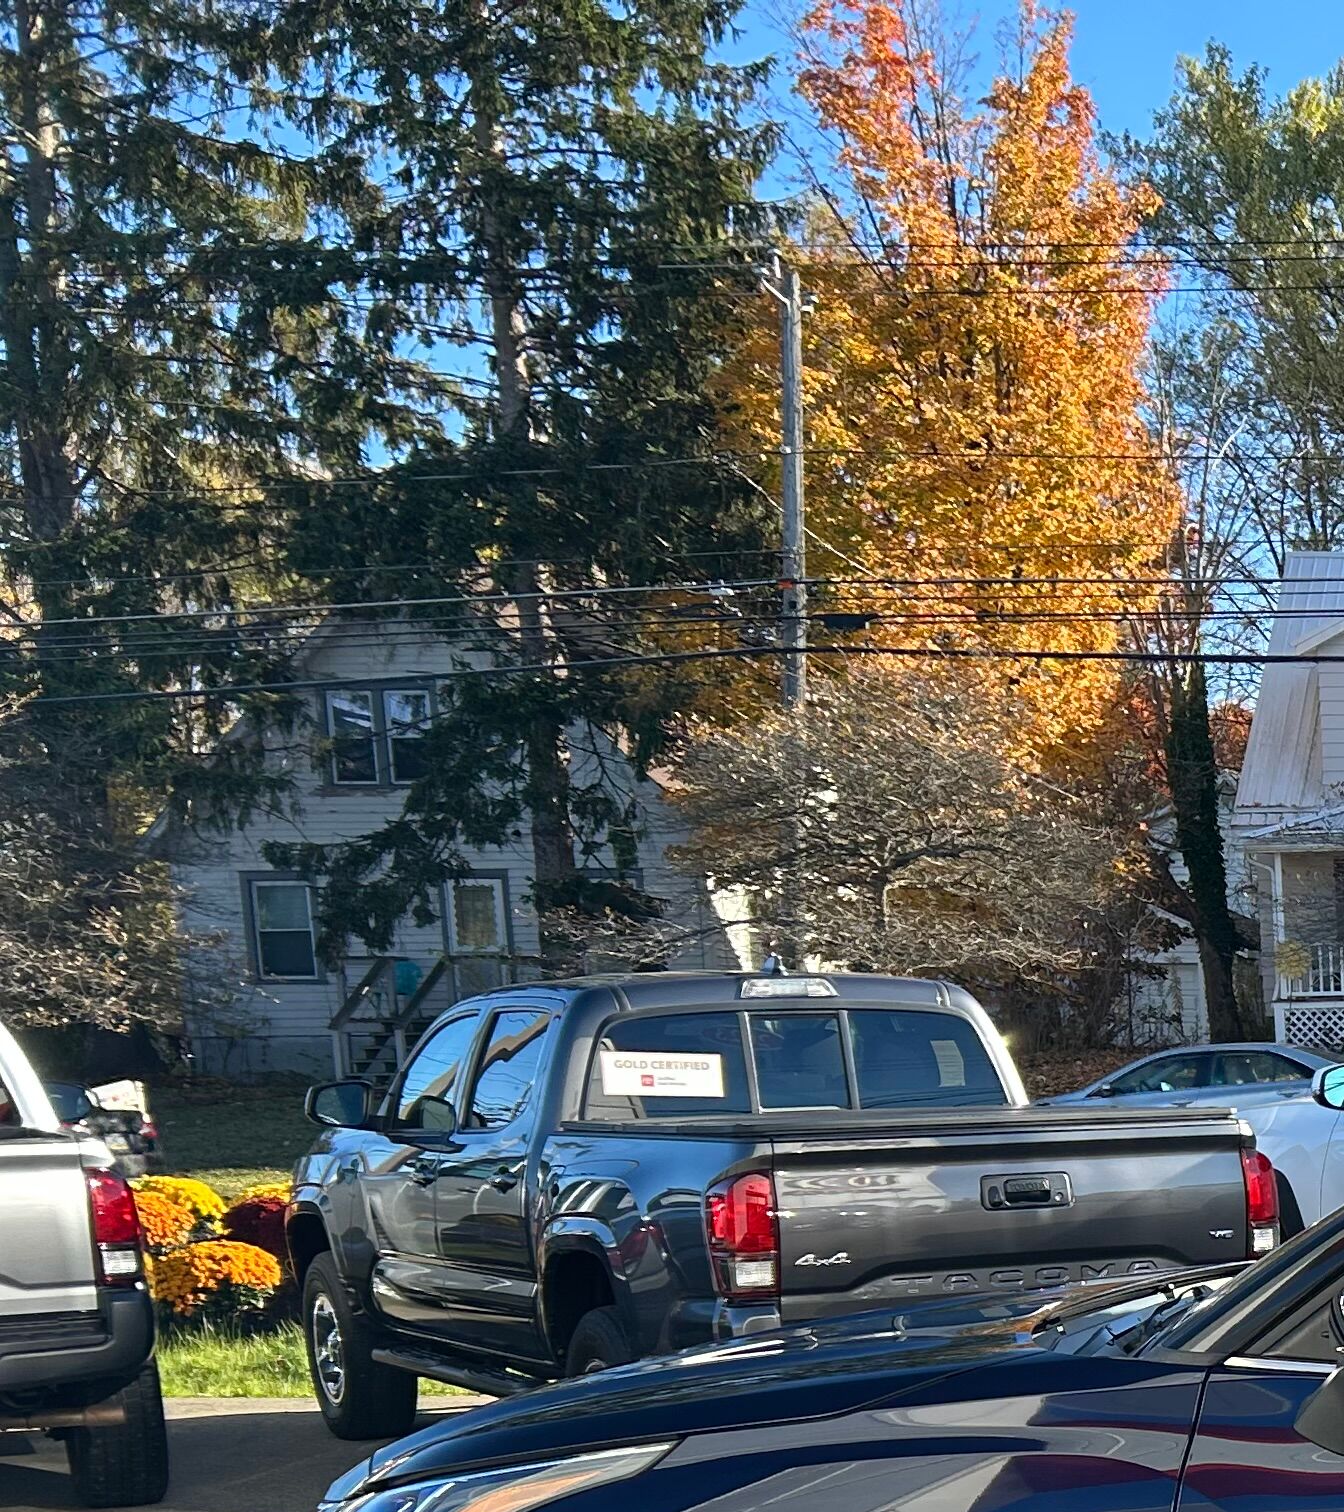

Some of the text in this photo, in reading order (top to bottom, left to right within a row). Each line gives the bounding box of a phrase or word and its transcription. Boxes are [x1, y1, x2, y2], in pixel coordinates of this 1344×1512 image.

[614, 1060, 710, 1070] GOLD CERTIFIED
[890, 1260, 1160, 1295] TACOMA
